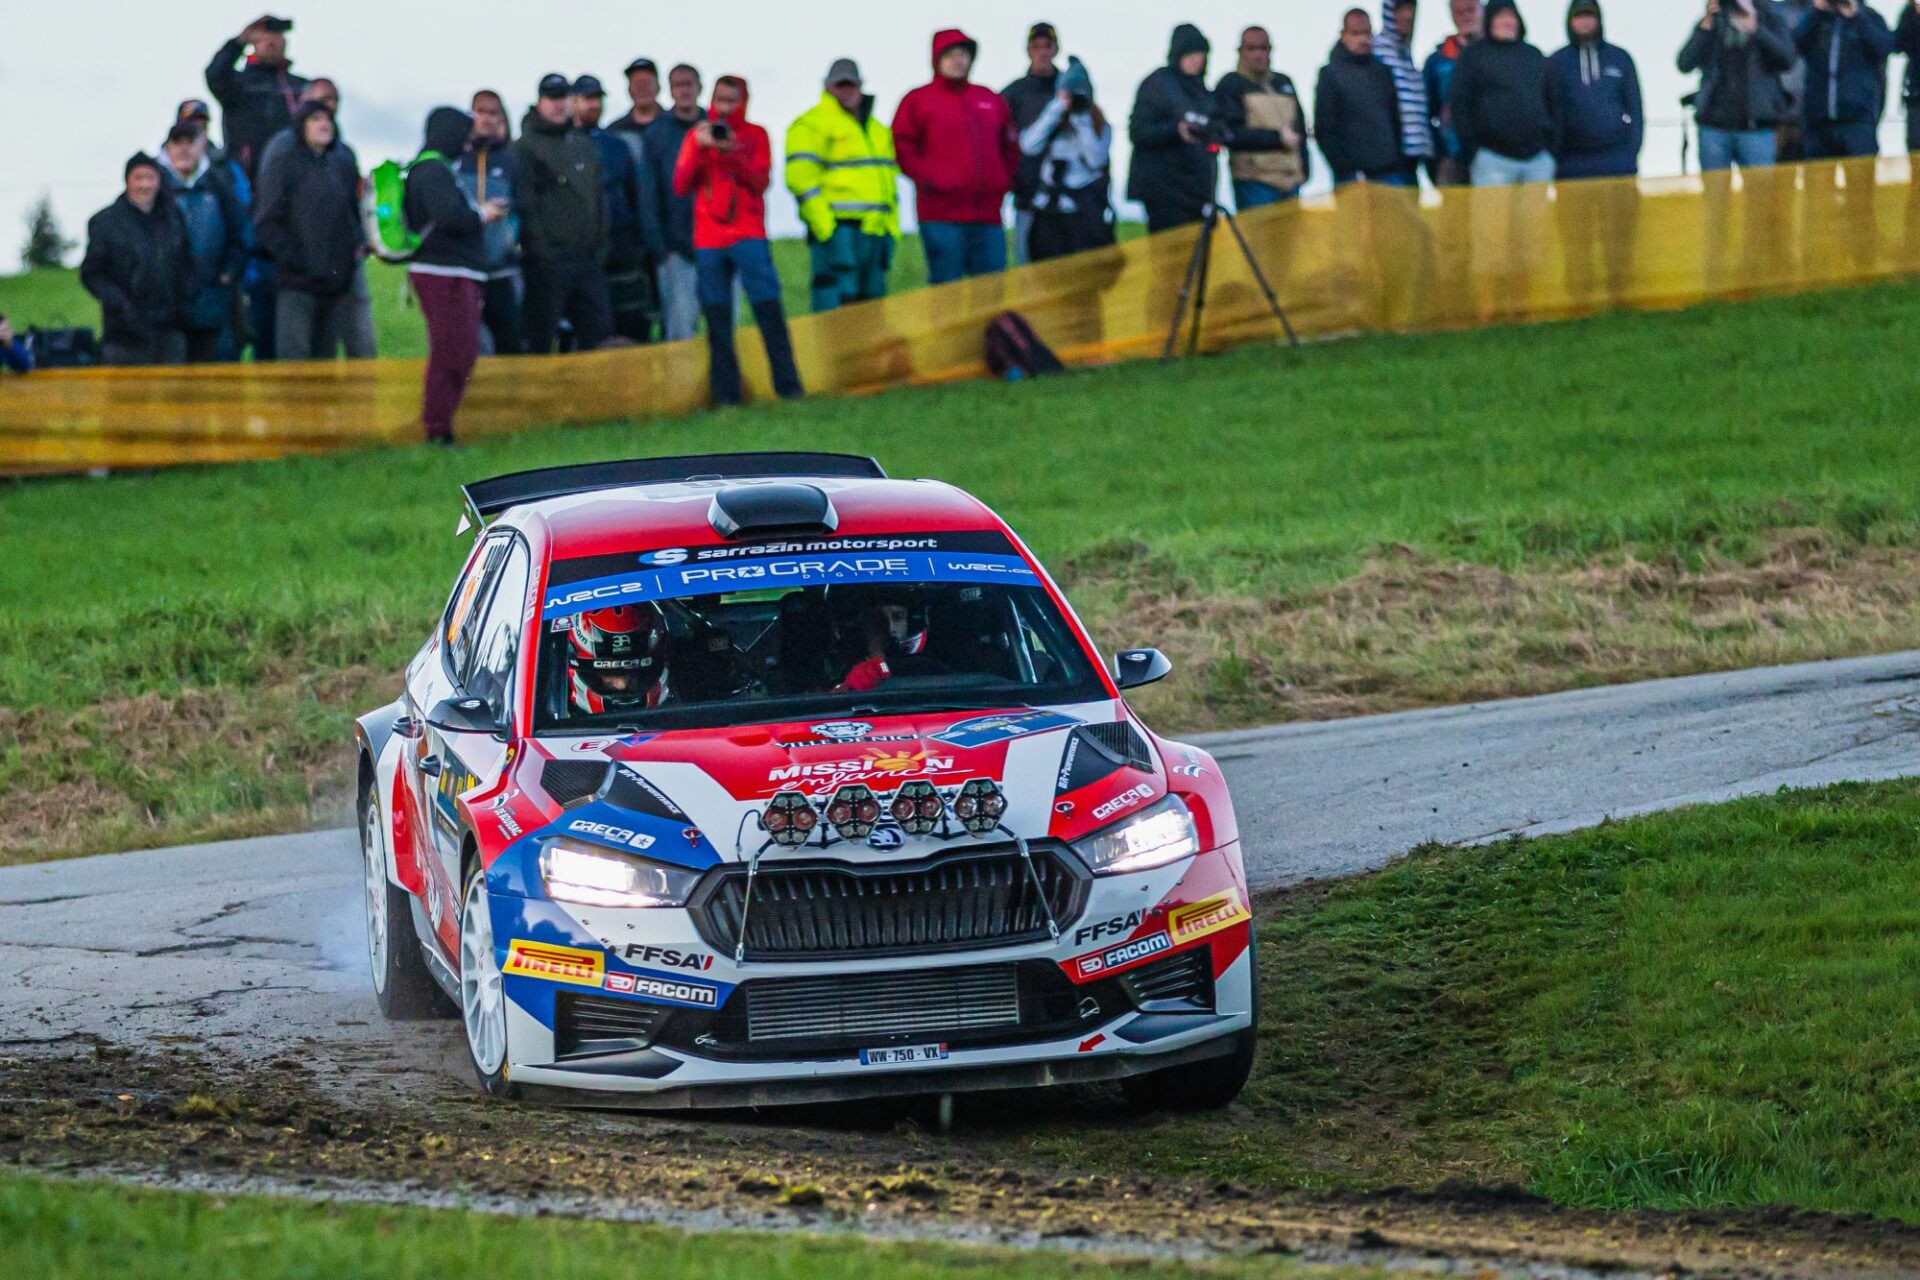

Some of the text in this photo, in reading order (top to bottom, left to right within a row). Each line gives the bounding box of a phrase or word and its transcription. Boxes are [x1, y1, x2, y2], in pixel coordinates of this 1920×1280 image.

[697, 539, 938, 559] sarrazin motorsport
[681, 558, 909, 584] PROGRADE
[803, 570, 910, 579] DIGITAL
[543, 582, 643, 608] WRC2
[774, 739, 830, 749] VILLE
[837, 736, 866, 745] DE
[1092, 788, 1140, 819] ORECA
[568, 820, 634, 839] ORECA
[1074, 910, 1141, 946] FFSA
[1177, 898, 1240, 937] PIRELLI
[512, 947, 596, 979] PIRELLI
[624, 943, 703, 971] FFSA
[1105, 934, 1168, 967] FACOM
[635, 979, 714, 1003] FACOM
